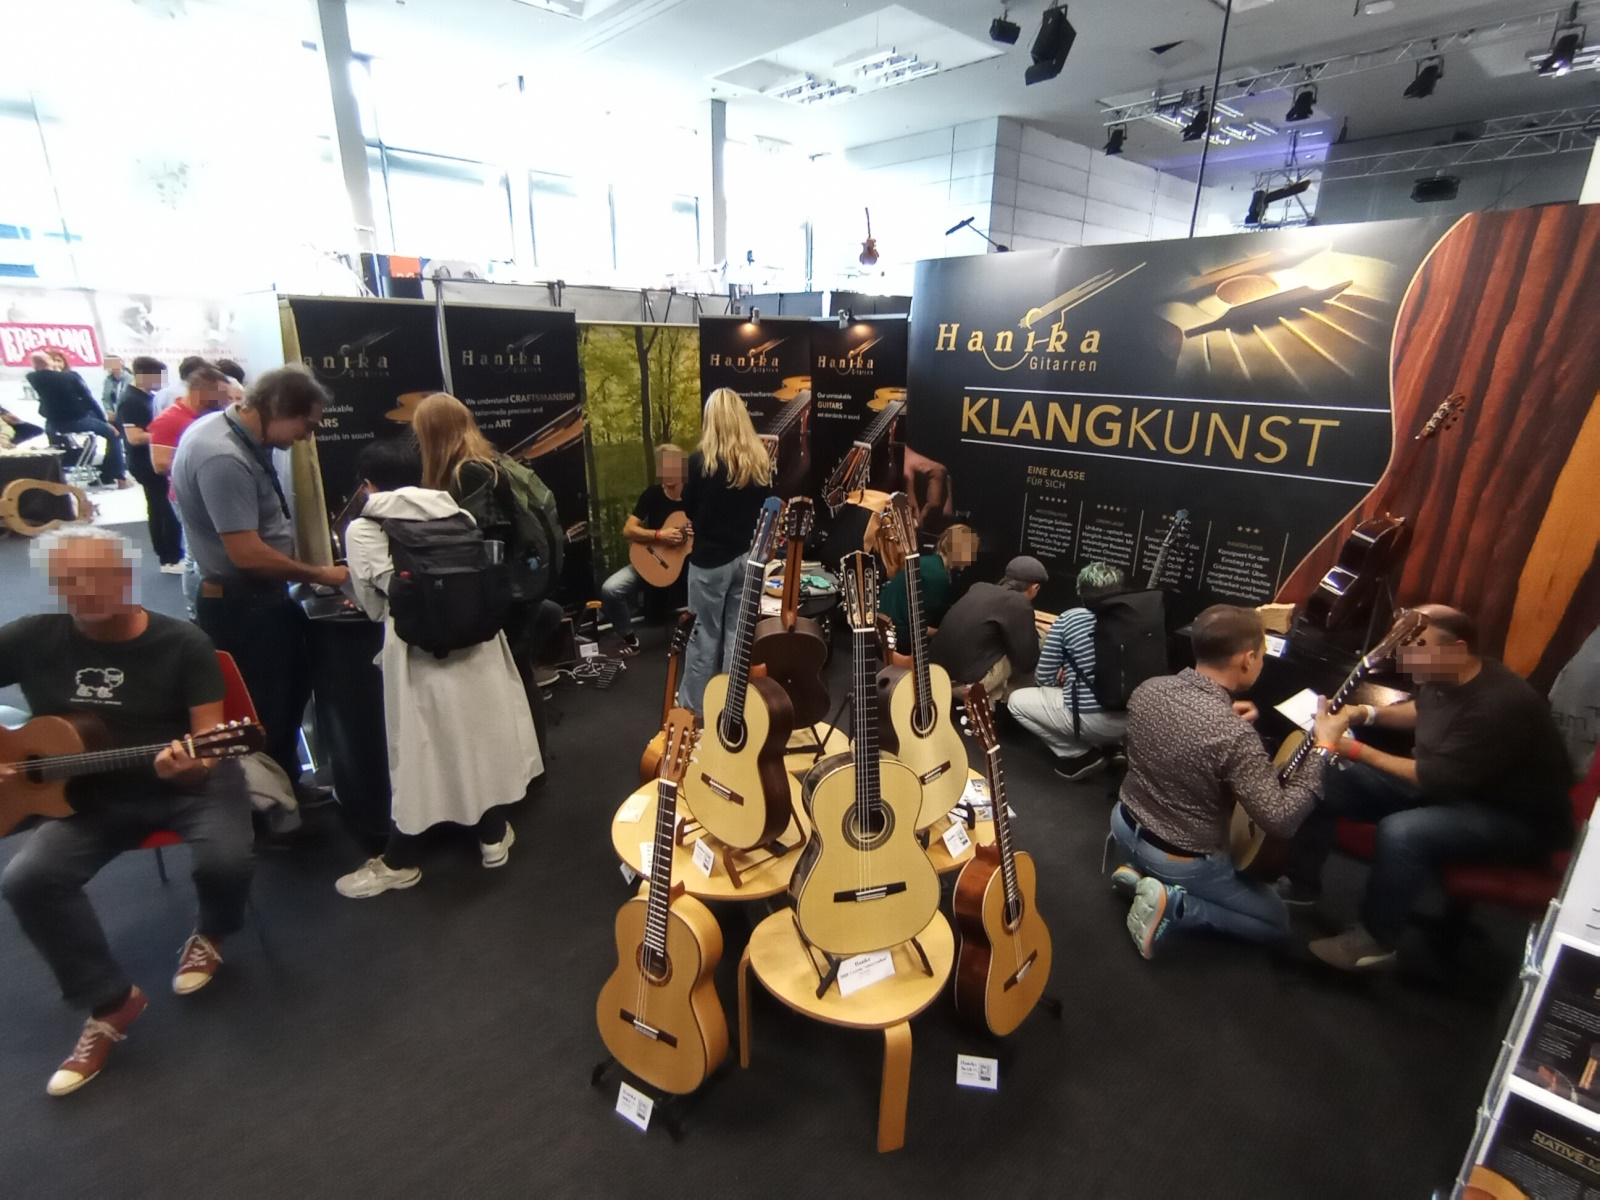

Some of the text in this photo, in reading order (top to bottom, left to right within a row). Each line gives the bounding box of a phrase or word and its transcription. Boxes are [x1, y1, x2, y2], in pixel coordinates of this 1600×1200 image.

[935, 322, 1101, 354] Hanika
[303, 353, 388, 369] anika
[462, 350, 541, 366] Hanika
[710, 353, 779, 367] Hanika
[818, 355, 874, 369] Hanika
[1029, 356, 1098, 372] Gitarren
[465, 392, 576, 406] We understand CRAFTSMANSHIP
[816, 391, 826, 399] Our
[817, 401, 843, 410] GUITARS
[495, 419, 512, 429] ART
[341, 432, 350, 440] in
[961, 396, 1340, 467] KLANGKUNST
[1027, 465, 1086, 481] EINE KLASSE
[1026, 476, 1066, 489] FÜR SICH
[1221, 556, 1245, 568] Einstieg
[1251, 562, 1264, 570] das
[1247, 552, 1257, 560] für
[1206, 576, 1241, 589] Spielbarkeit
[1239, 584, 1253, 592] und
[1232, 574, 1251, 583] durch
[1250, 578, 1271, 588] leichte
[1531, 1131, 1586, 1164] NATIVE
